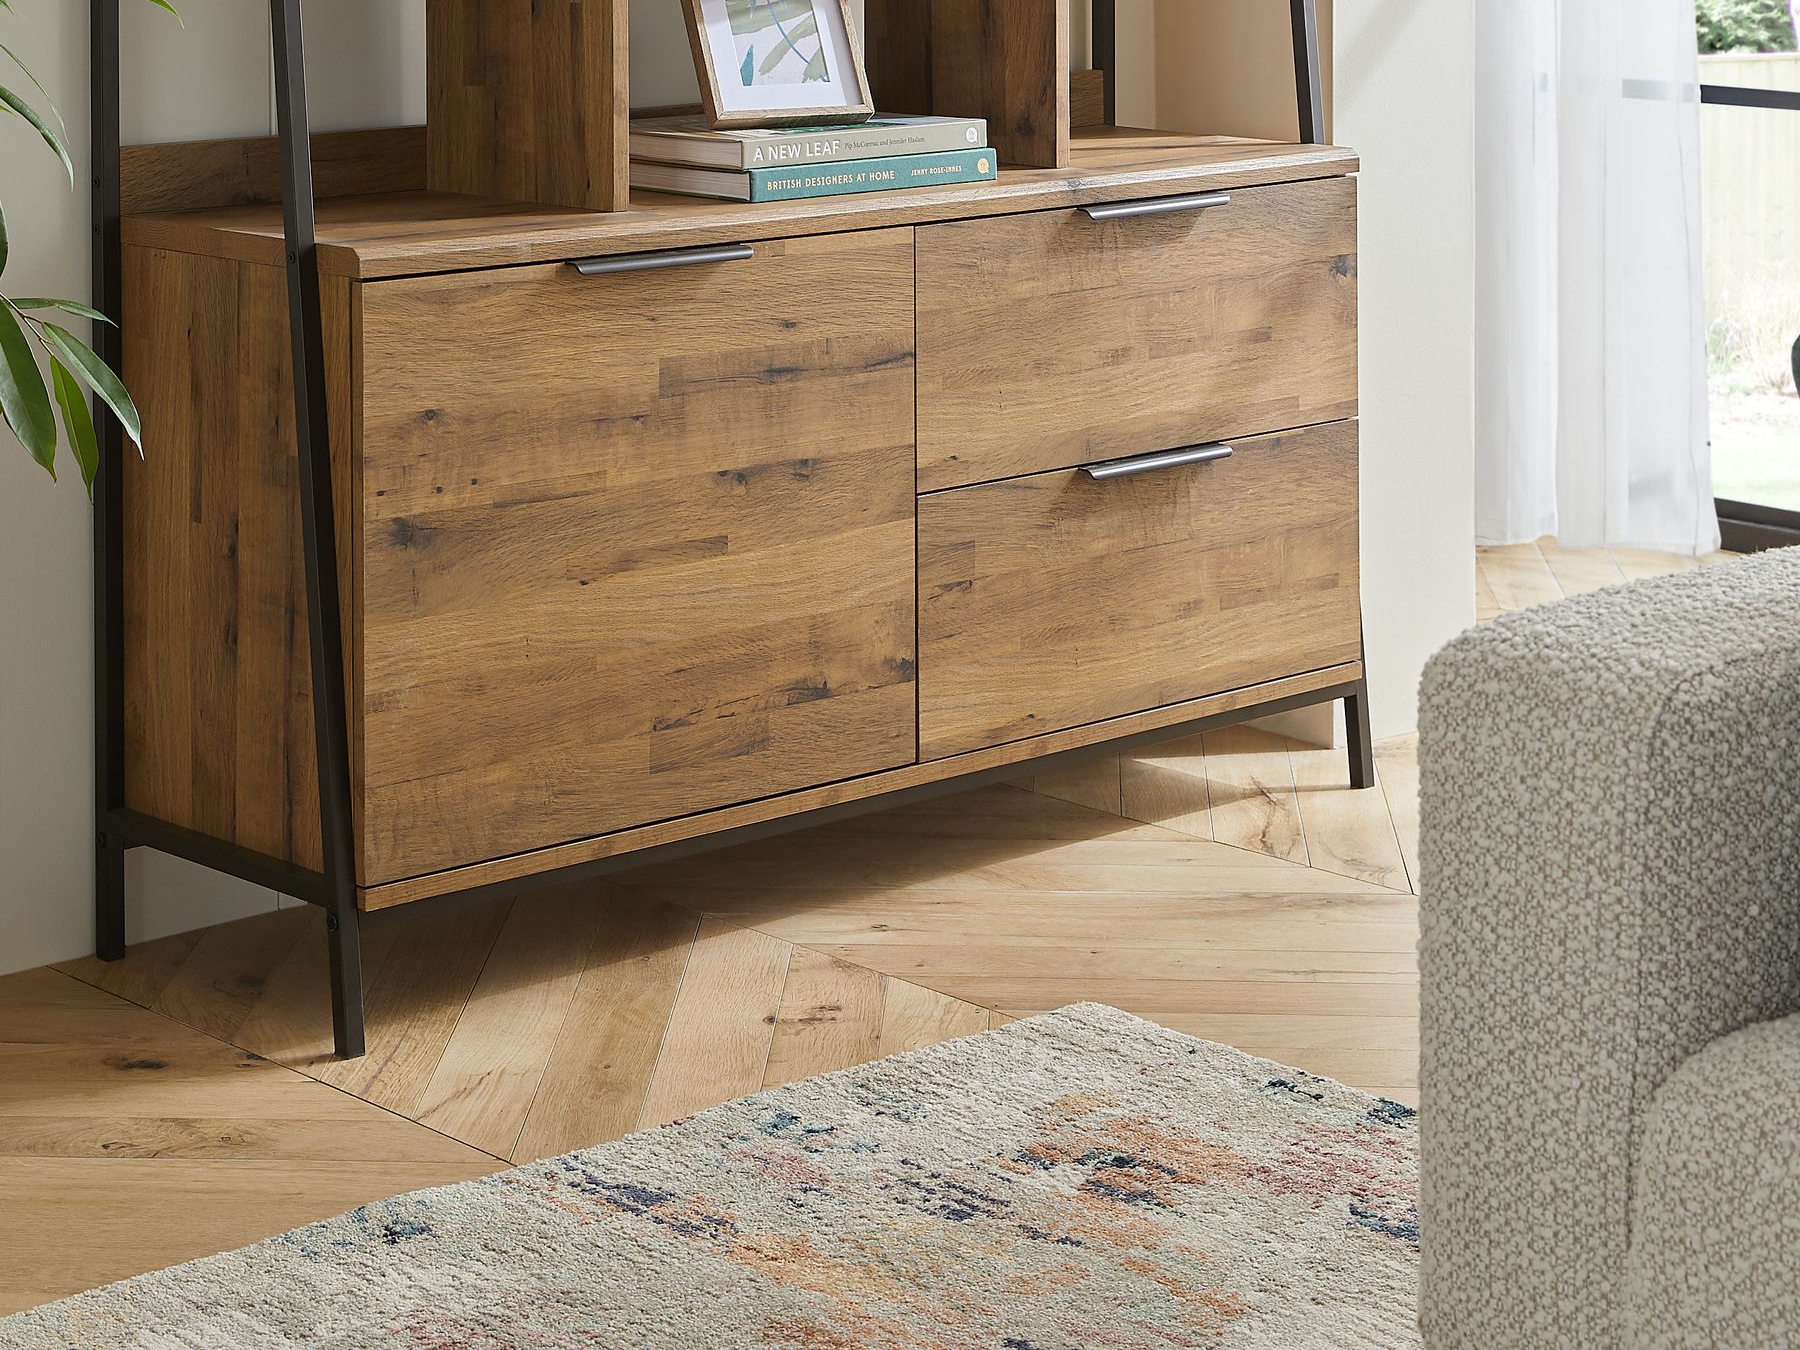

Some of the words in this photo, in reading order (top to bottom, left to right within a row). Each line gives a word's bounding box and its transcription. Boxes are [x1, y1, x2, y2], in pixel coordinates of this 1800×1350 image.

[753, 147, 764, 162] A
[768, 143, 802, 161] NEW
[806, 139, 841, 157] LEAF
[888, 137, 907, 147] Jennifer
[767, 179, 802, 191] BRITISH
[805, 174, 853, 187] DESIGNERS
[856, 173, 867, 183] AT
[869, 170, 895, 181] HOME
[911, 167, 928, 176] JENNY
[929, 165, 962, 175] ROSE-INNES
